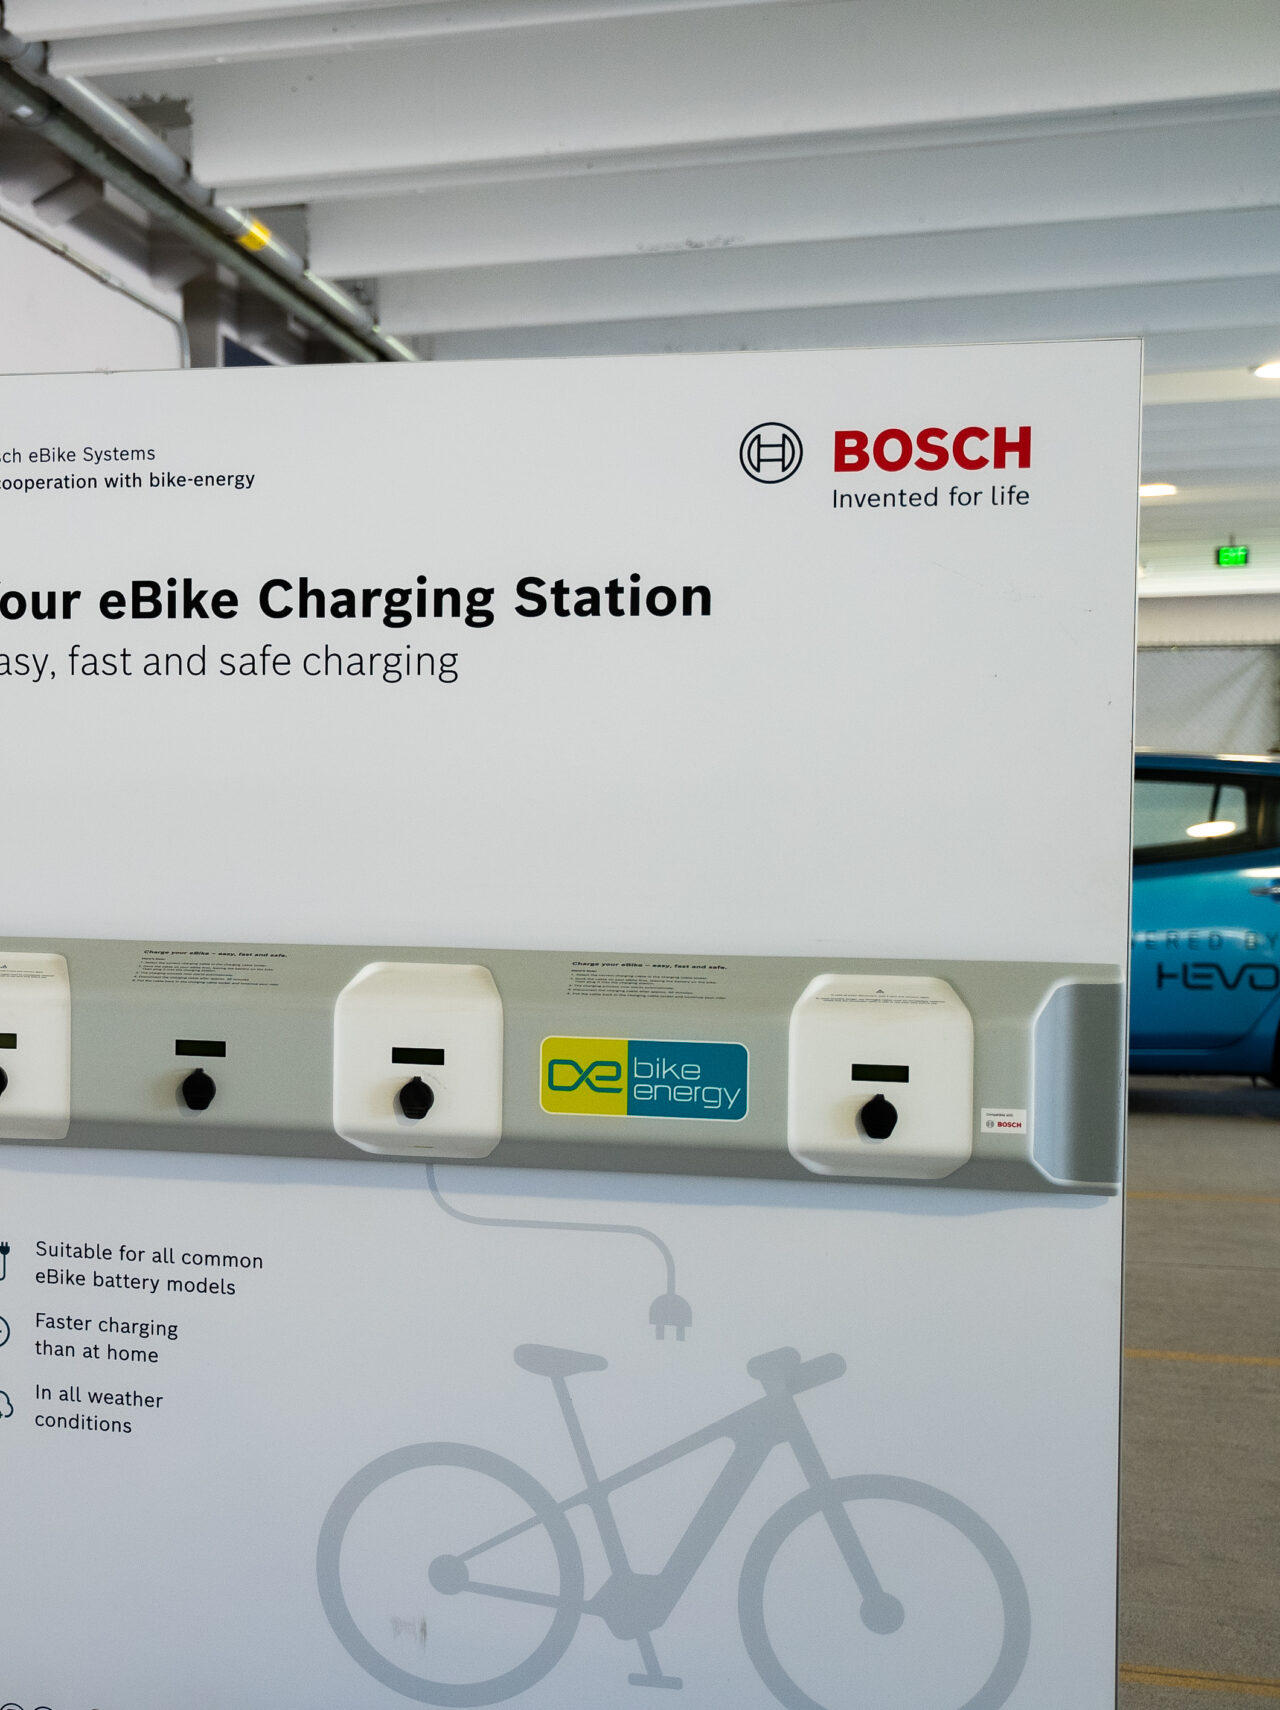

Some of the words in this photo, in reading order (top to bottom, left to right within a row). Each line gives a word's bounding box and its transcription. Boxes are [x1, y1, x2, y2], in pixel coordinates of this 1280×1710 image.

[29, 447, 75, 462] eBike
[84, 447, 155, 464] Systems
[834, 426, 1031, 472] BOSCH
[104, 473, 141, 488] with
[150, 472, 254, 489] bike-energy
[834, 487, 937, 508] Invented
[949, 486, 983, 506] for
[992, 485, 1029, 505] life
[100, 578, 238, 619] eBike
[260, 575, 494, 628] Charging
[515, 573, 711, 617] Station
[69, 645, 132, 675] fast
[144, 645, 205, 675] and
[220, 644, 290, 675] safe
[304, 644, 458, 683] charging
[143, 949, 170, 957] Charge
[1156, 962, 1280, 991] HEVO
[634, 1057, 700, 1080] bike
[634, 1084, 741, 1109] energy
[36, 1241, 112, 1260] Suitable
[120, 1245, 145, 1261] for
[152, 1248, 175, 1264] all
[182, 1253, 262, 1268] common
[36, 1269, 85, 1286] eBike
[94, 1271, 159, 1293] battery
[168, 1277, 235, 1295] models
[37, 1313, 92, 1331] Faster
[99, 1317, 178, 1340] charging
[35, 1340, 74, 1357] than
[83, 1345, 100, 1359] at
[108, 1344, 158, 1363] home
[37, 1384, 51, 1400] In
[59, 1386, 81, 1402] all
[88, 1391, 163, 1408] weather
[35, 1414, 131, 1433] conditions
